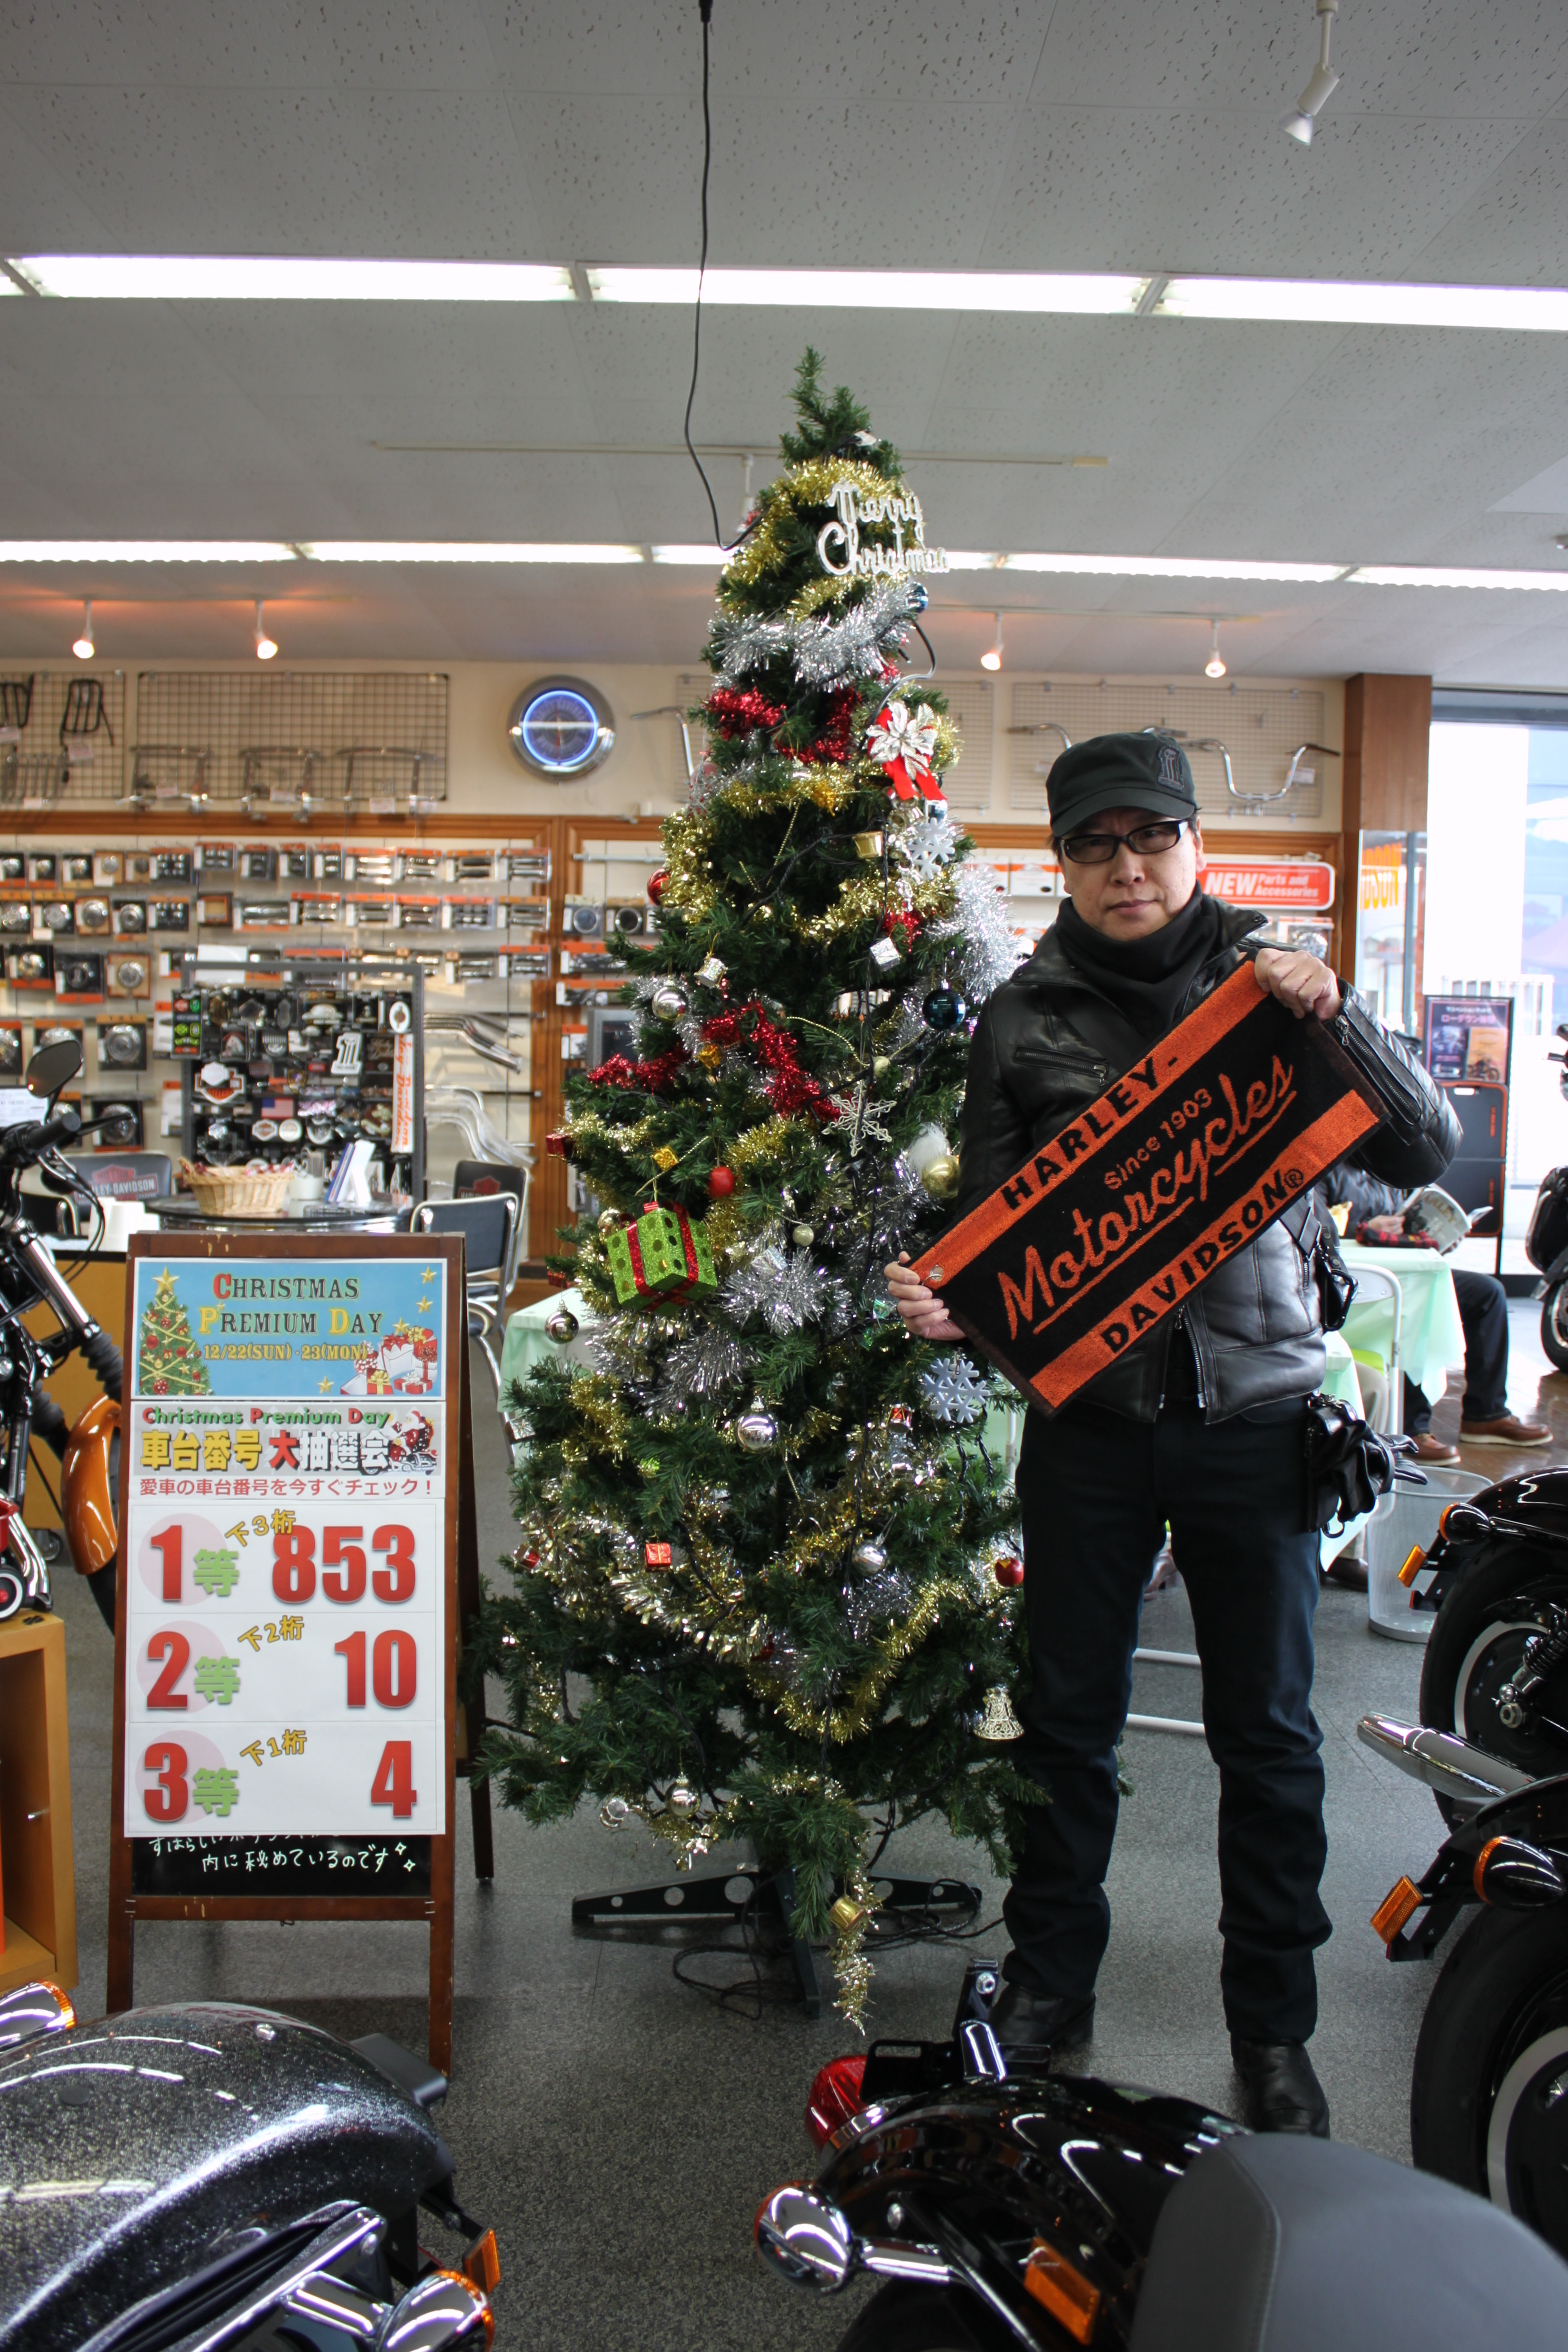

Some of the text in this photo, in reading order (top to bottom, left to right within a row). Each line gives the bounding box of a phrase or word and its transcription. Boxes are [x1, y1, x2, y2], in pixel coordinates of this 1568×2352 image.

[1204, 872, 1309, 896] NEW Parts and
[1254, 886, 1319, 898] Accessories
[1001, 1054, 1179, 1211] HARLEY-
[1103, 1086, 1215, 1190] Since 1903
[997, 1054, 1294, 1340] Motorcycles
[213, 1273, 360, 1300] CHRISTMAS
[198, 1307, 384, 1335] PREMIUM DAY
[142, 1406, 390, 1430] Christmas Premium Day
[140, 1429, 392, 1473] 車台番号 大抽選会
[225, 1509, 295, 1548] 下3桁
[272, 1525, 416, 1603] 853
[238, 1615, 304, 1652] 下2桁
[334, 1630, 417, 1708] 10
[240, 1729, 307, 1766] 下1桁
[371, 1740, 417, 1818] 4
[201, 1843, 389, 1873] 内に秘めているのです
